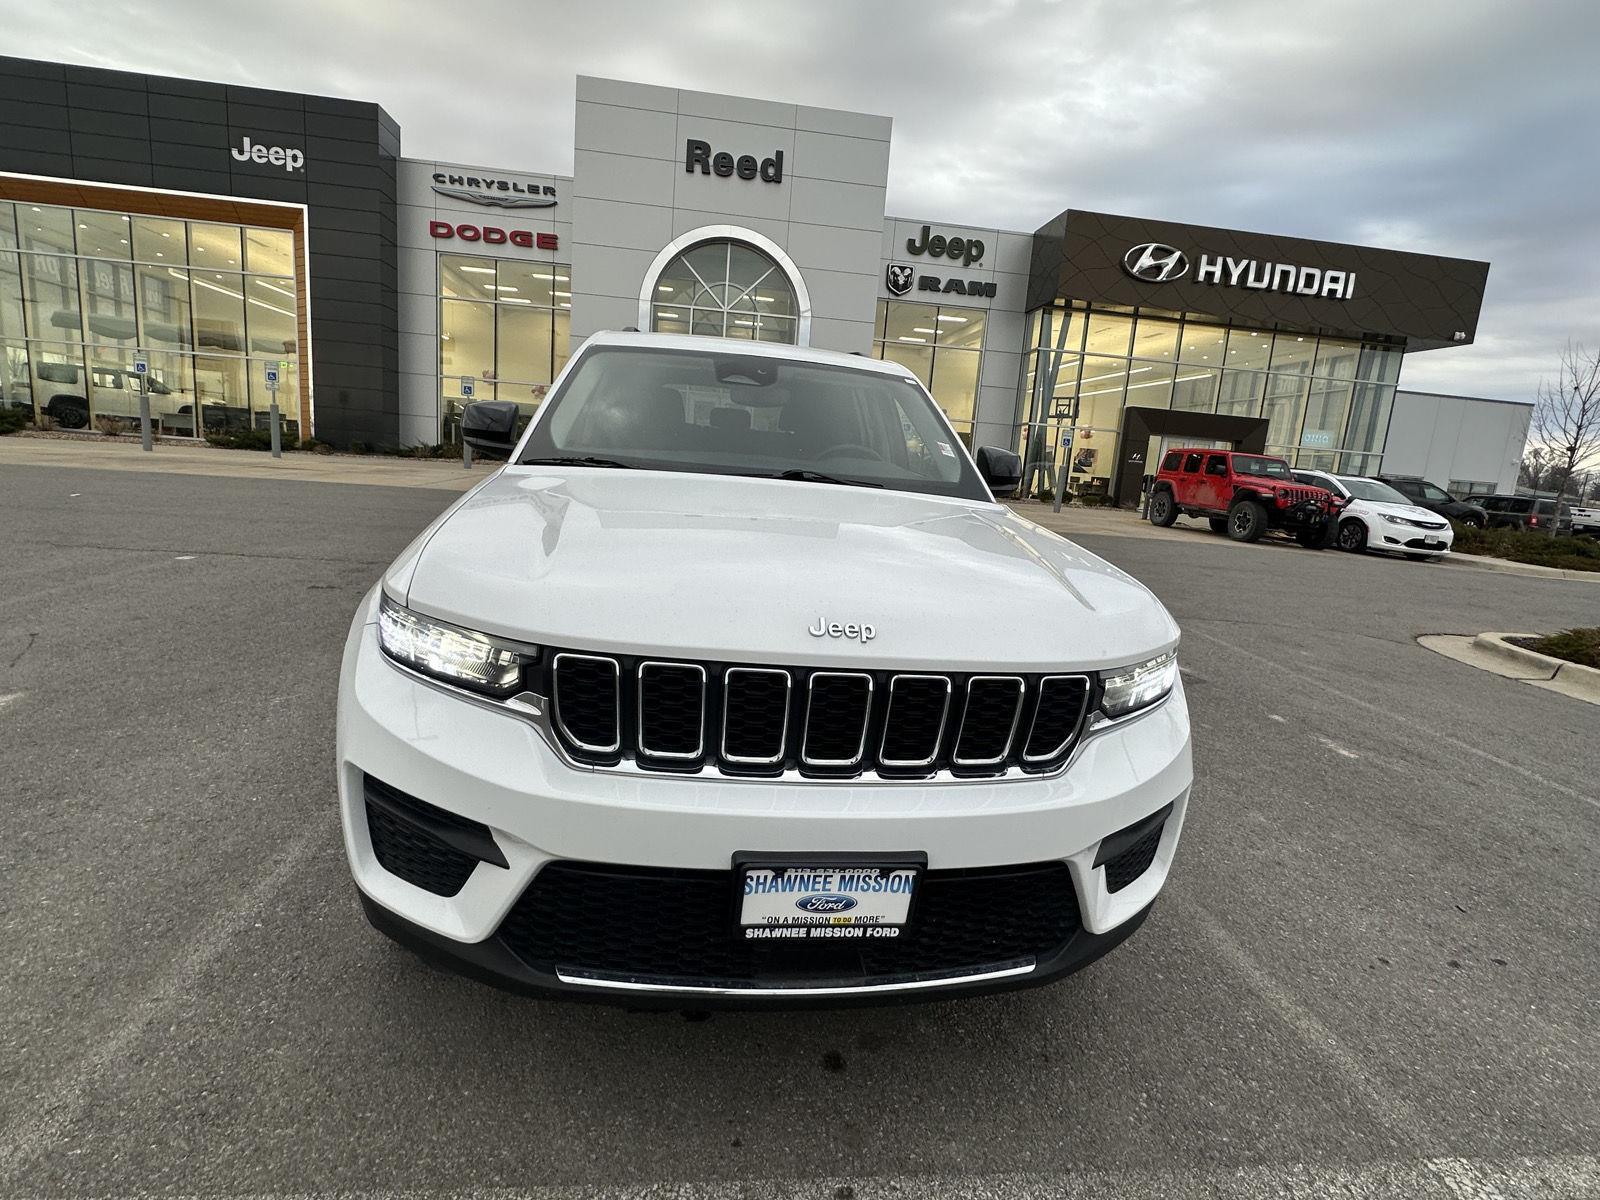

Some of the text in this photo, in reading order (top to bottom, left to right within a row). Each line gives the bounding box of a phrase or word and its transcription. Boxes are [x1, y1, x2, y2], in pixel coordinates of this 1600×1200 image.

[231, 137, 304, 171] Jeep
[685, 138, 784, 184] Reed
[432, 173, 557, 196] CHRYSLER
[429, 220, 558, 250] DODGE
[906, 225, 985, 267] Jeep
[918, 275, 997, 298] RAM
[1198, 254, 1356, 300] HYUNDAI
[808, 616, 877, 643] Jeep
[744, 873, 914, 896] SHAWNEE MISSION
[806, 896, 848, 911] Ford
[745, 927, 900, 938] SHAWNEE MISSION FORD
[783, 916, 789, 924] A
[791, 916, 831, 924] MISSION
